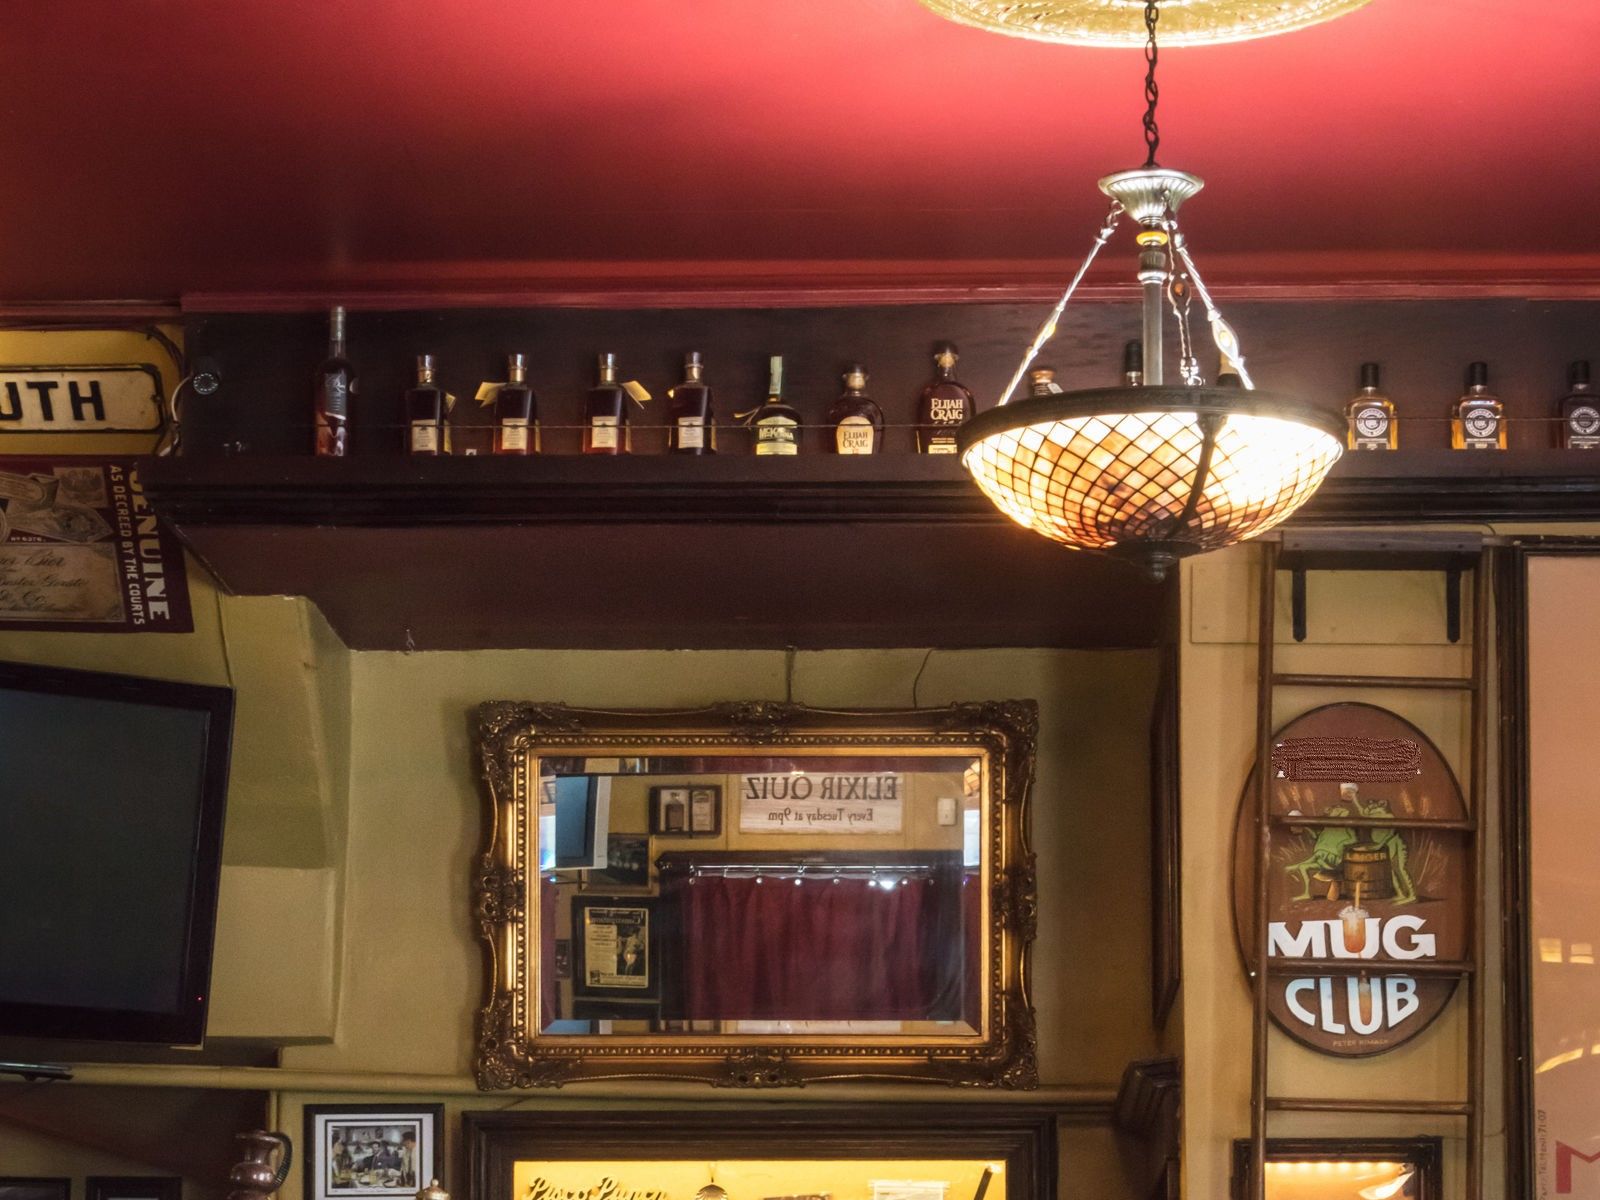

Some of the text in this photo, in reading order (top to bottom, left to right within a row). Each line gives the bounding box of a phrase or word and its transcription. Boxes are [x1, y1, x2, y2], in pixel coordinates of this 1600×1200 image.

[930, 398, 964, 410] ELIJAH
[930, 408, 964, 421] CRAIG
[113, 485, 134, 538] DECREED
[124, 558, 140, 580] THE
[128, 584, 146, 625] COURTS
[1268, 914, 1436, 960] MUG
[1285, 974, 1420, 1035] CLUB
